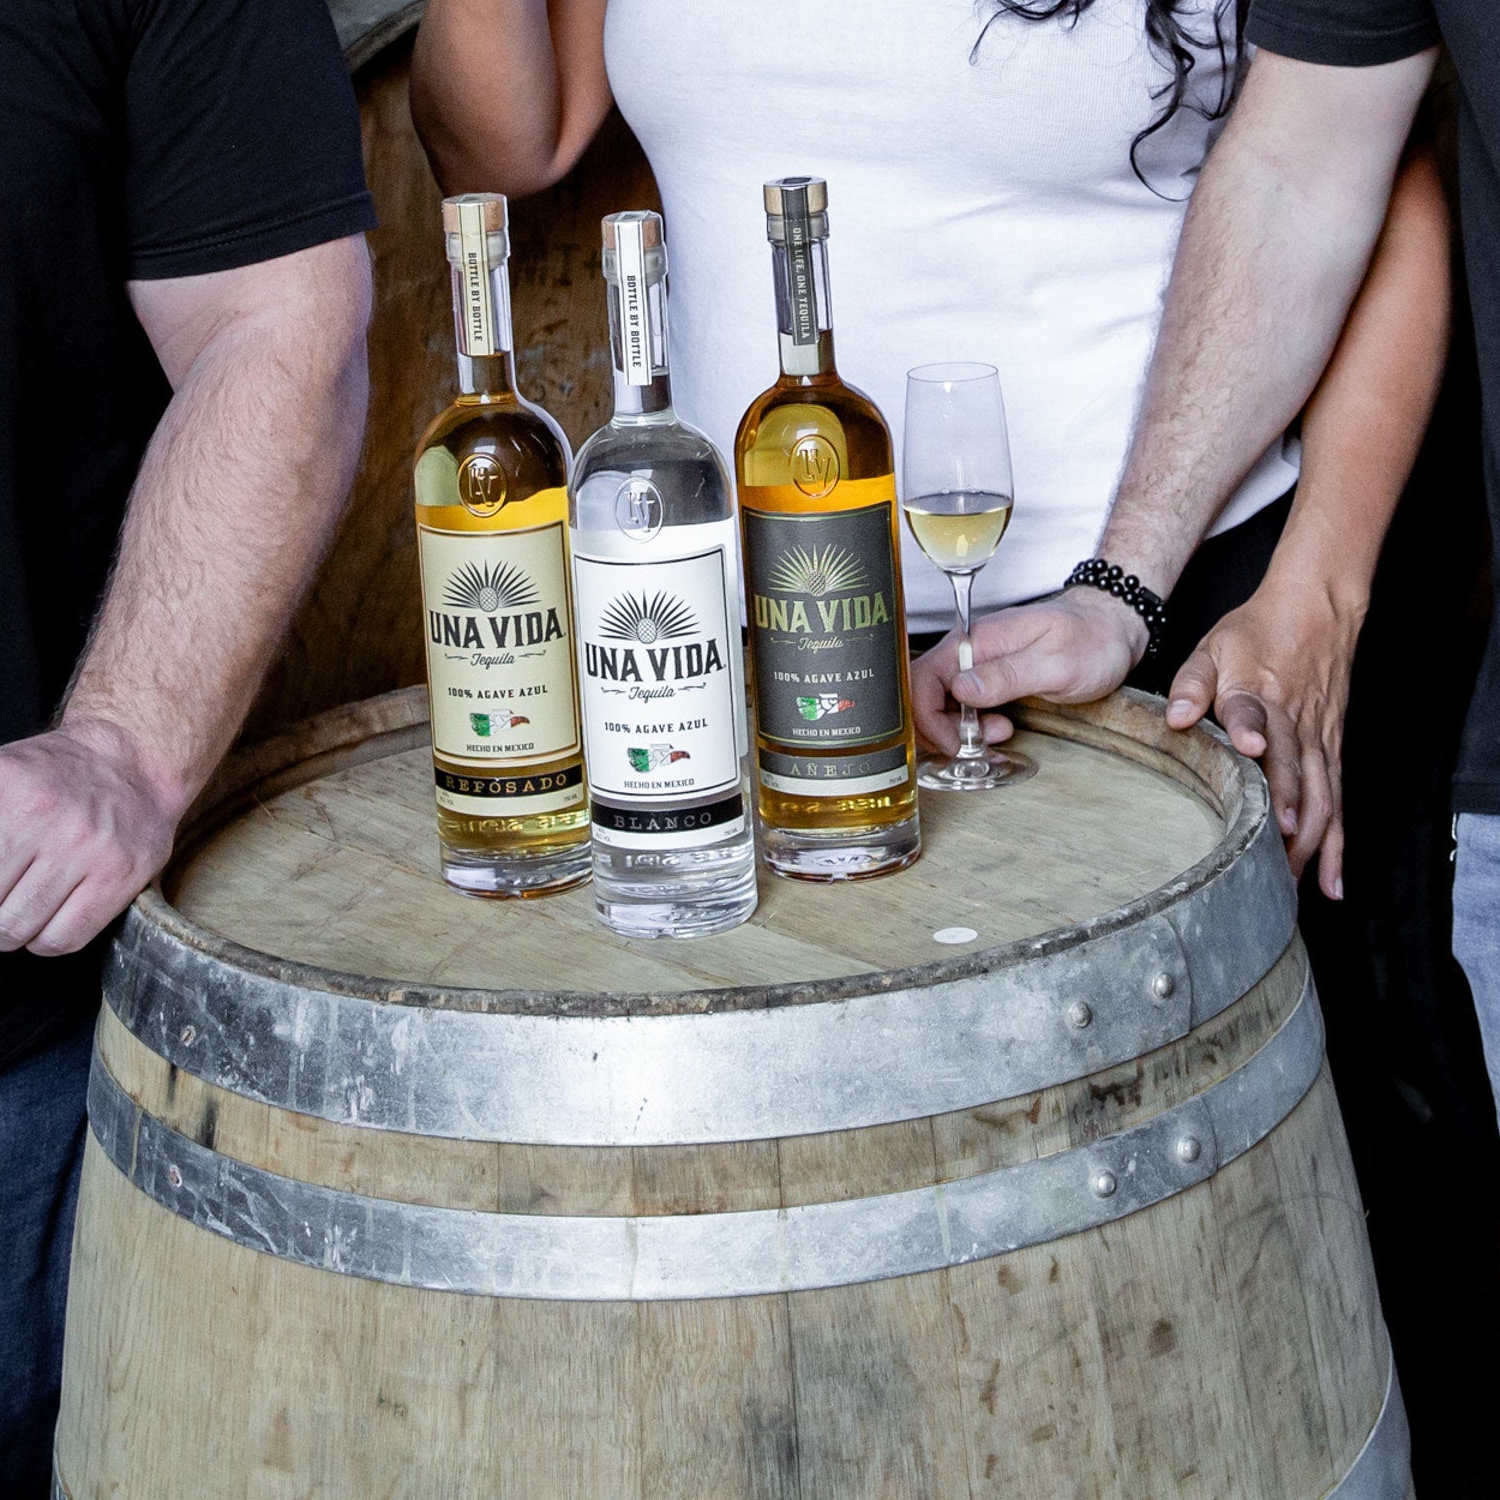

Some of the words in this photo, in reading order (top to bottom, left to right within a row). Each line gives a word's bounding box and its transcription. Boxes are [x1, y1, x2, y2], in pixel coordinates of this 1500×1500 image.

[793, 227, 803, 245] ONE
[468, 252, 480, 287] BOTTLE
[627, 275, 638, 311] BOTTLE
[797, 275, 807, 295] ONE
[471, 290, 481, 302] BY
[472, 306, 483, 341] BOTTLE
[629, 314, 639, 327] BY
[799, 298, 811, 339] TEQUILA
[631, 331, 642, 367] BOTTLE
[754, 594, 813, 633] UNA
[816, 591, 889, 633] VIDA
[429, 610, 485, 649] UNA
[488, 607, 564, 649] VIDA
[798, 636, 845, 654] Tequila
[470, 652, 516, 670] Tequila
[585, 642, 644, 682] UNA
[646, 638, 724, 682] VIDA
[773, 671, 800, 683] 100%
[804, 673, 842, 684] AGAVE
[846, 668, 875, 681] AZUL
[448, 687, 473, 698] 100%
[477, 689, 514, 699] AGAVE
[519, 685, 548, 697] AZUL
[628, 685, 676, 704] Tequila
[604, 722, 631, 733] 100%
[635, 723, 674, 734] AGAVE
[679, 718, 708, 732] AZUL
[792, 728, 818, 736] HECHO
[819, 728, 830, 736] EN
[831, 726, 861, 736] MEXICO
[789, 761, 871, 777] AÑEJO
[444, 773, 567, 794] REPOSADO
[624, 780, 650, 789] HECHO
[652, 781, 662, 789] EN
[664, 778, 695, 788] MEXICO
[613, 812, 712, 830] BLANCO
